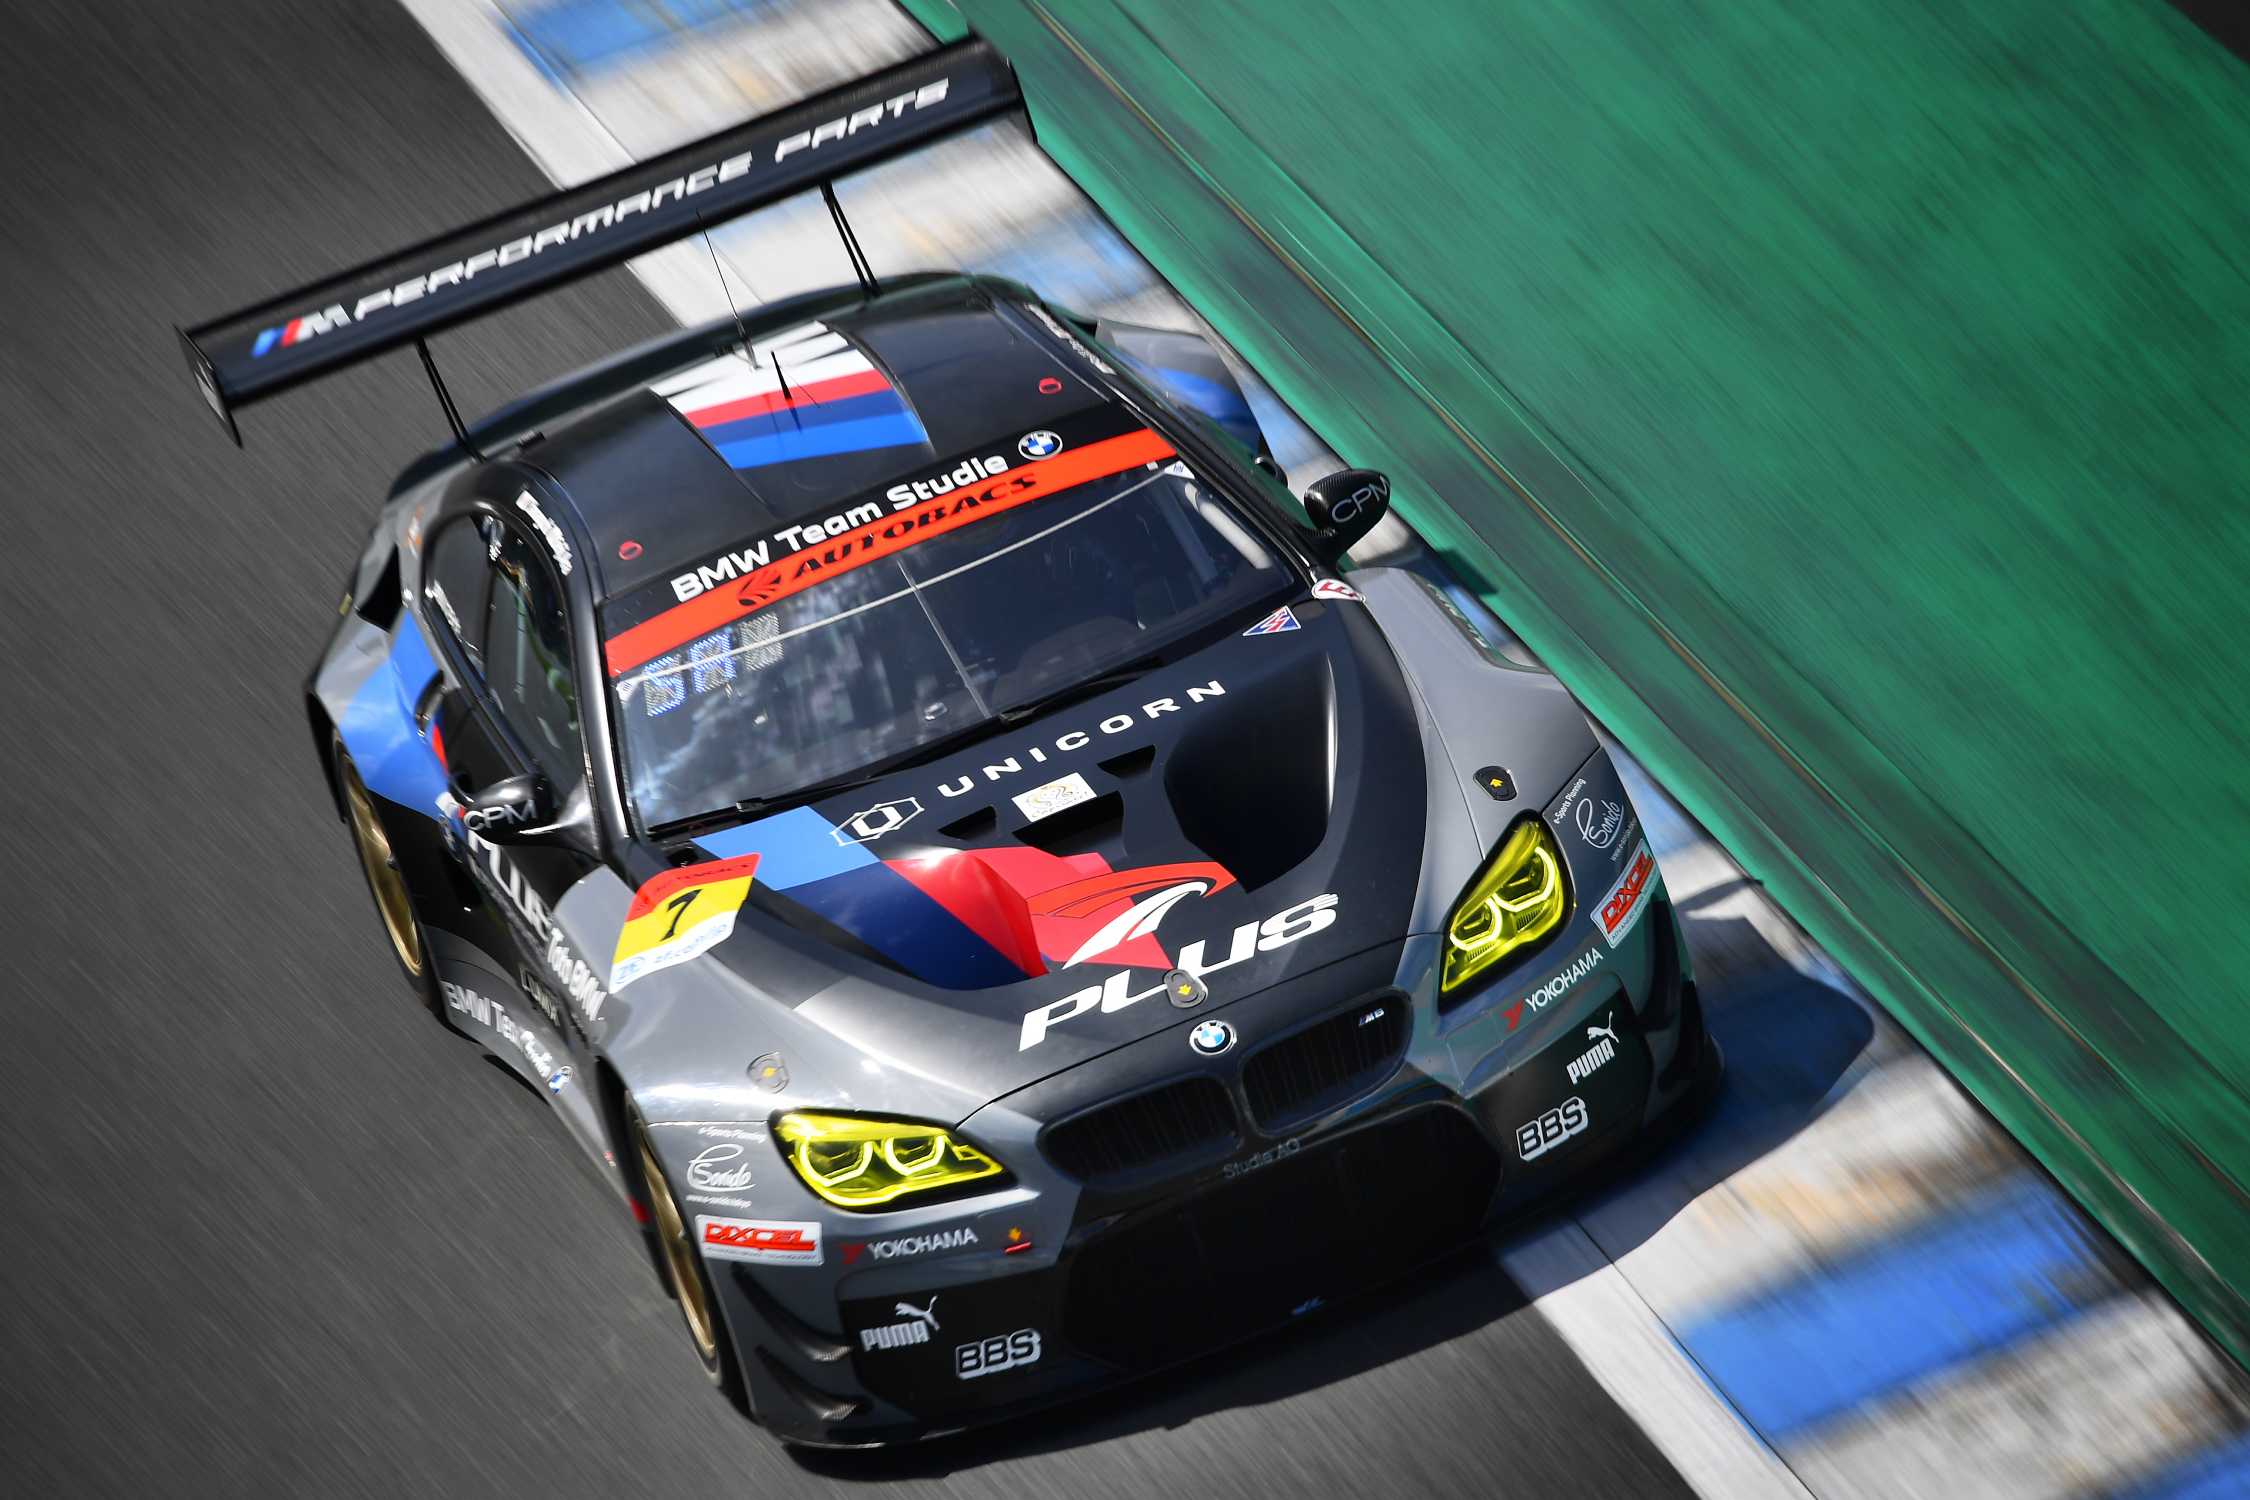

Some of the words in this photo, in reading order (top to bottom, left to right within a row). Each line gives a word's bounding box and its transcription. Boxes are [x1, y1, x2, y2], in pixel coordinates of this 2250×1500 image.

[353, 151, 753, 322] PERFORMANCE
[774, 77, 949, 163] PARTS
[670, 539, 772, 603] BMW
[774, 498, 881, 552] Team
[887, 454, 1008, 511] Studie
[793, 471, 1038, 579] AUTOBACS
[937, 680, 1227, 798] UNICORN
[463, 799, 537, 831] CPM
[660, 888, 703, 942] 7
[1018, 893, 1339, 1052] PLUS
[1525, 946, 1604, 1013] YOKOHAMA
[1566, 1037, 1616, 1085] PUMA
[1516, 1096, 1589, 1161] BBS
[1222, 1149, 1273, 1180] Studie
[867, 1227, 979, 1260] YOKOHAMA
[860, 1320, 931, 1352] PUMA
[955, 1328, 1042, 1381] BBS
